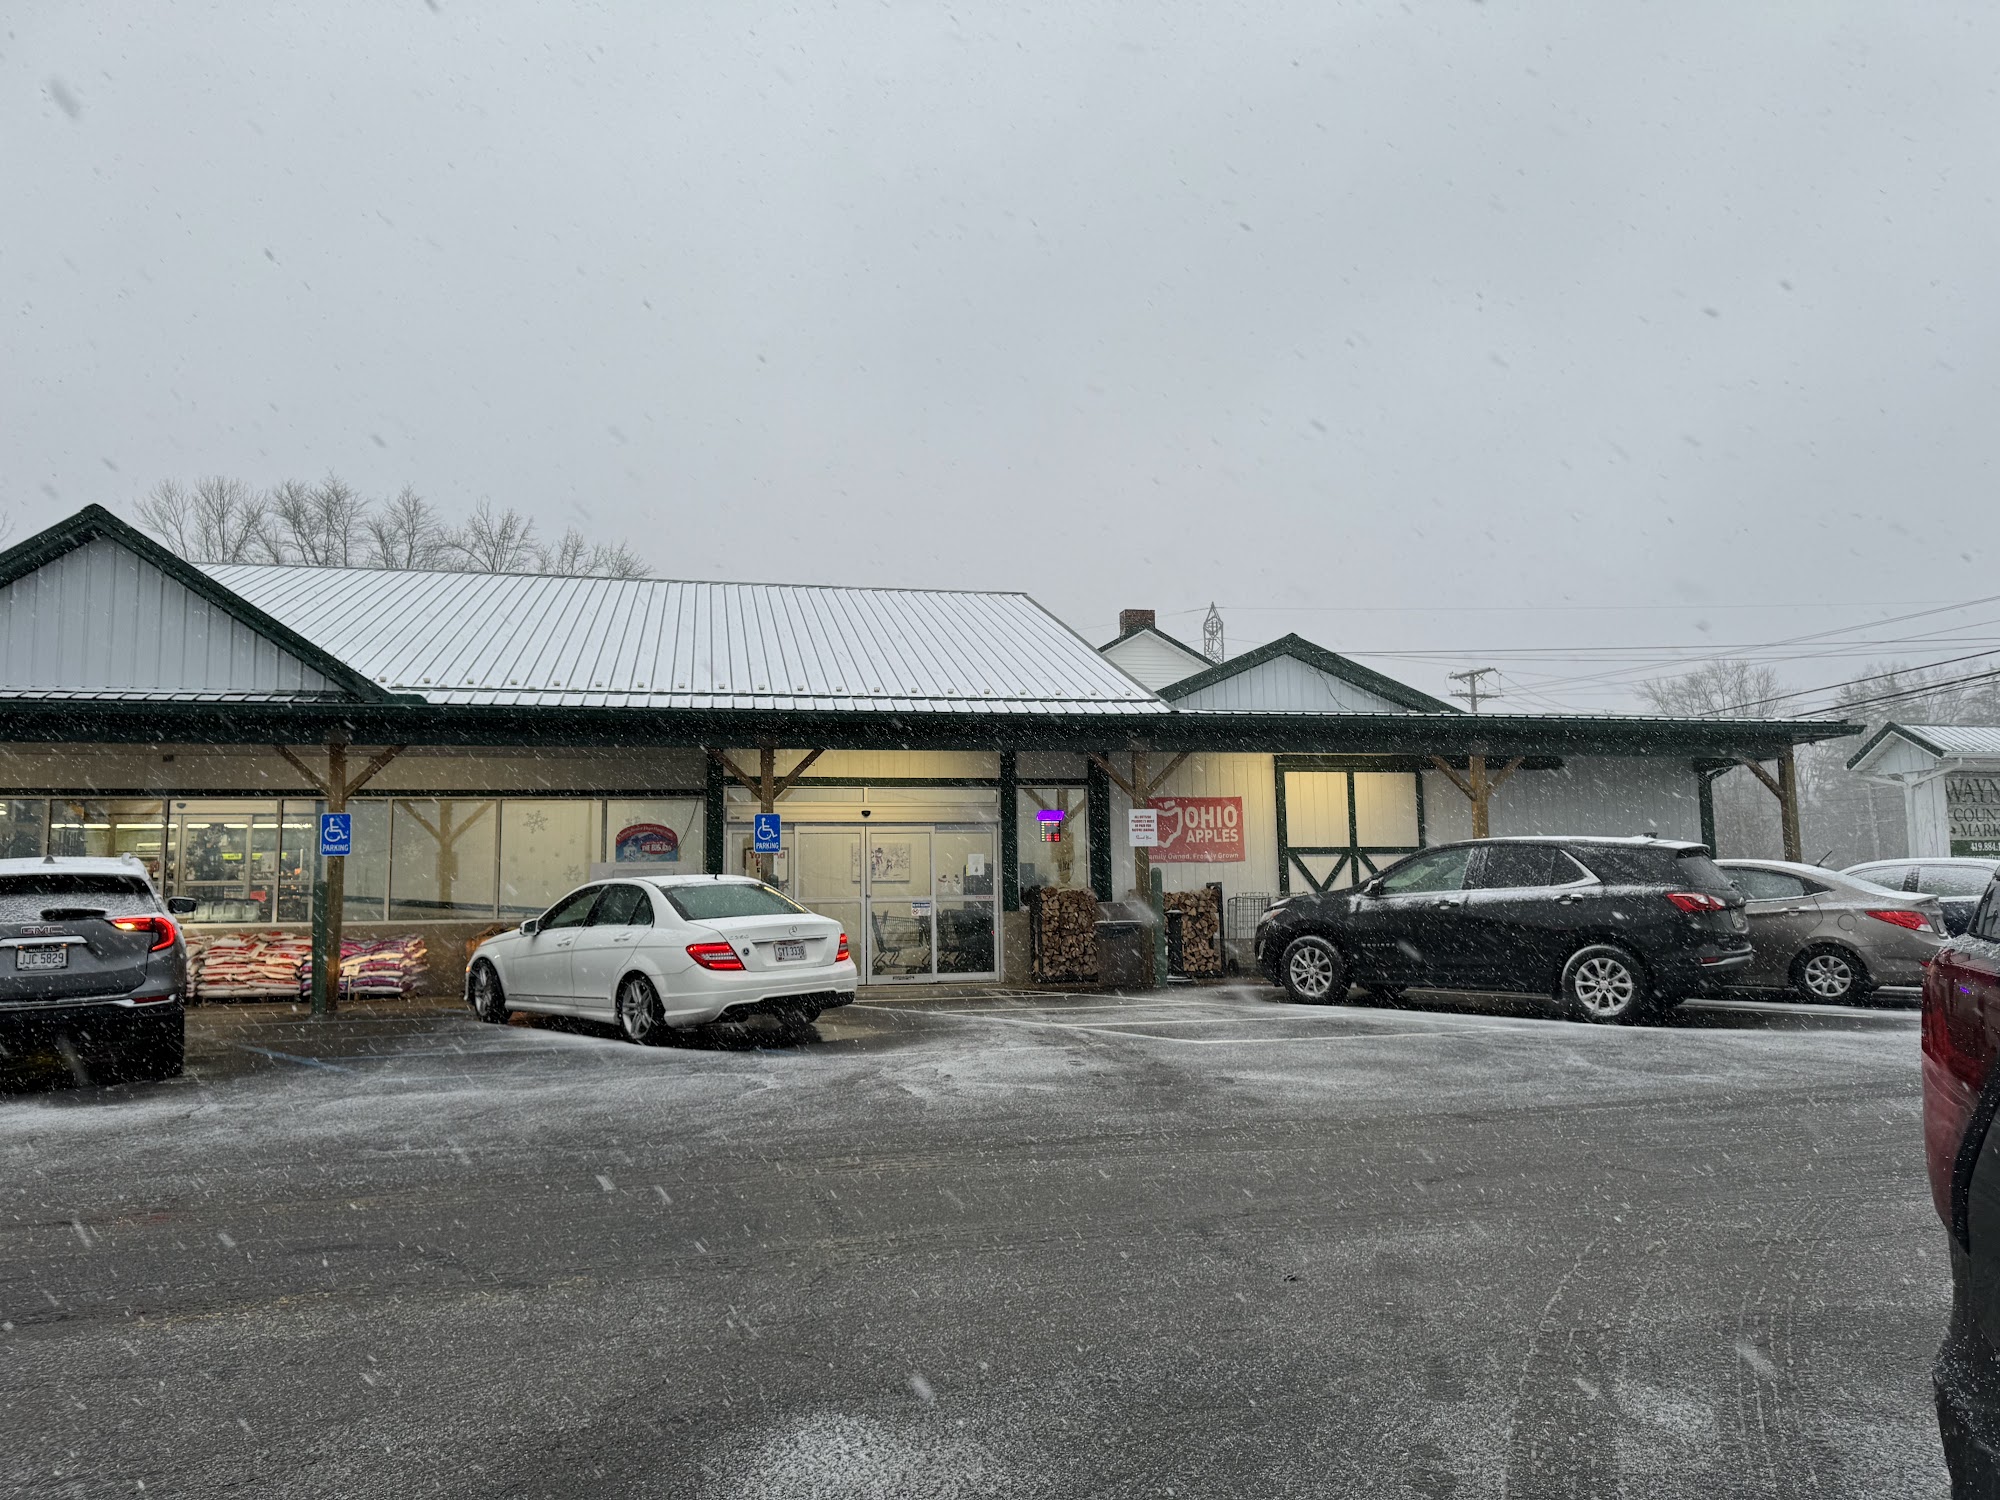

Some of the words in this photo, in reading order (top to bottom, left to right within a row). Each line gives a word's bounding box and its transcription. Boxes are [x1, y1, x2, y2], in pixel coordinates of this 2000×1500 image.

[1184, 806, 1238, 828] OHIO
[1186, 829, 1239, 842] APPLES
[1960, 823, 2000, 837] MARK
[322, 843, 349, 852] PARKING
[756, 842, 779, 850] PARKING
[1148, 852, 1166, 861] amily
[21, 925, 63, 935] GMC
[20, 953, 38, 965] JJC
[40, 952, 64, 964] 5829
